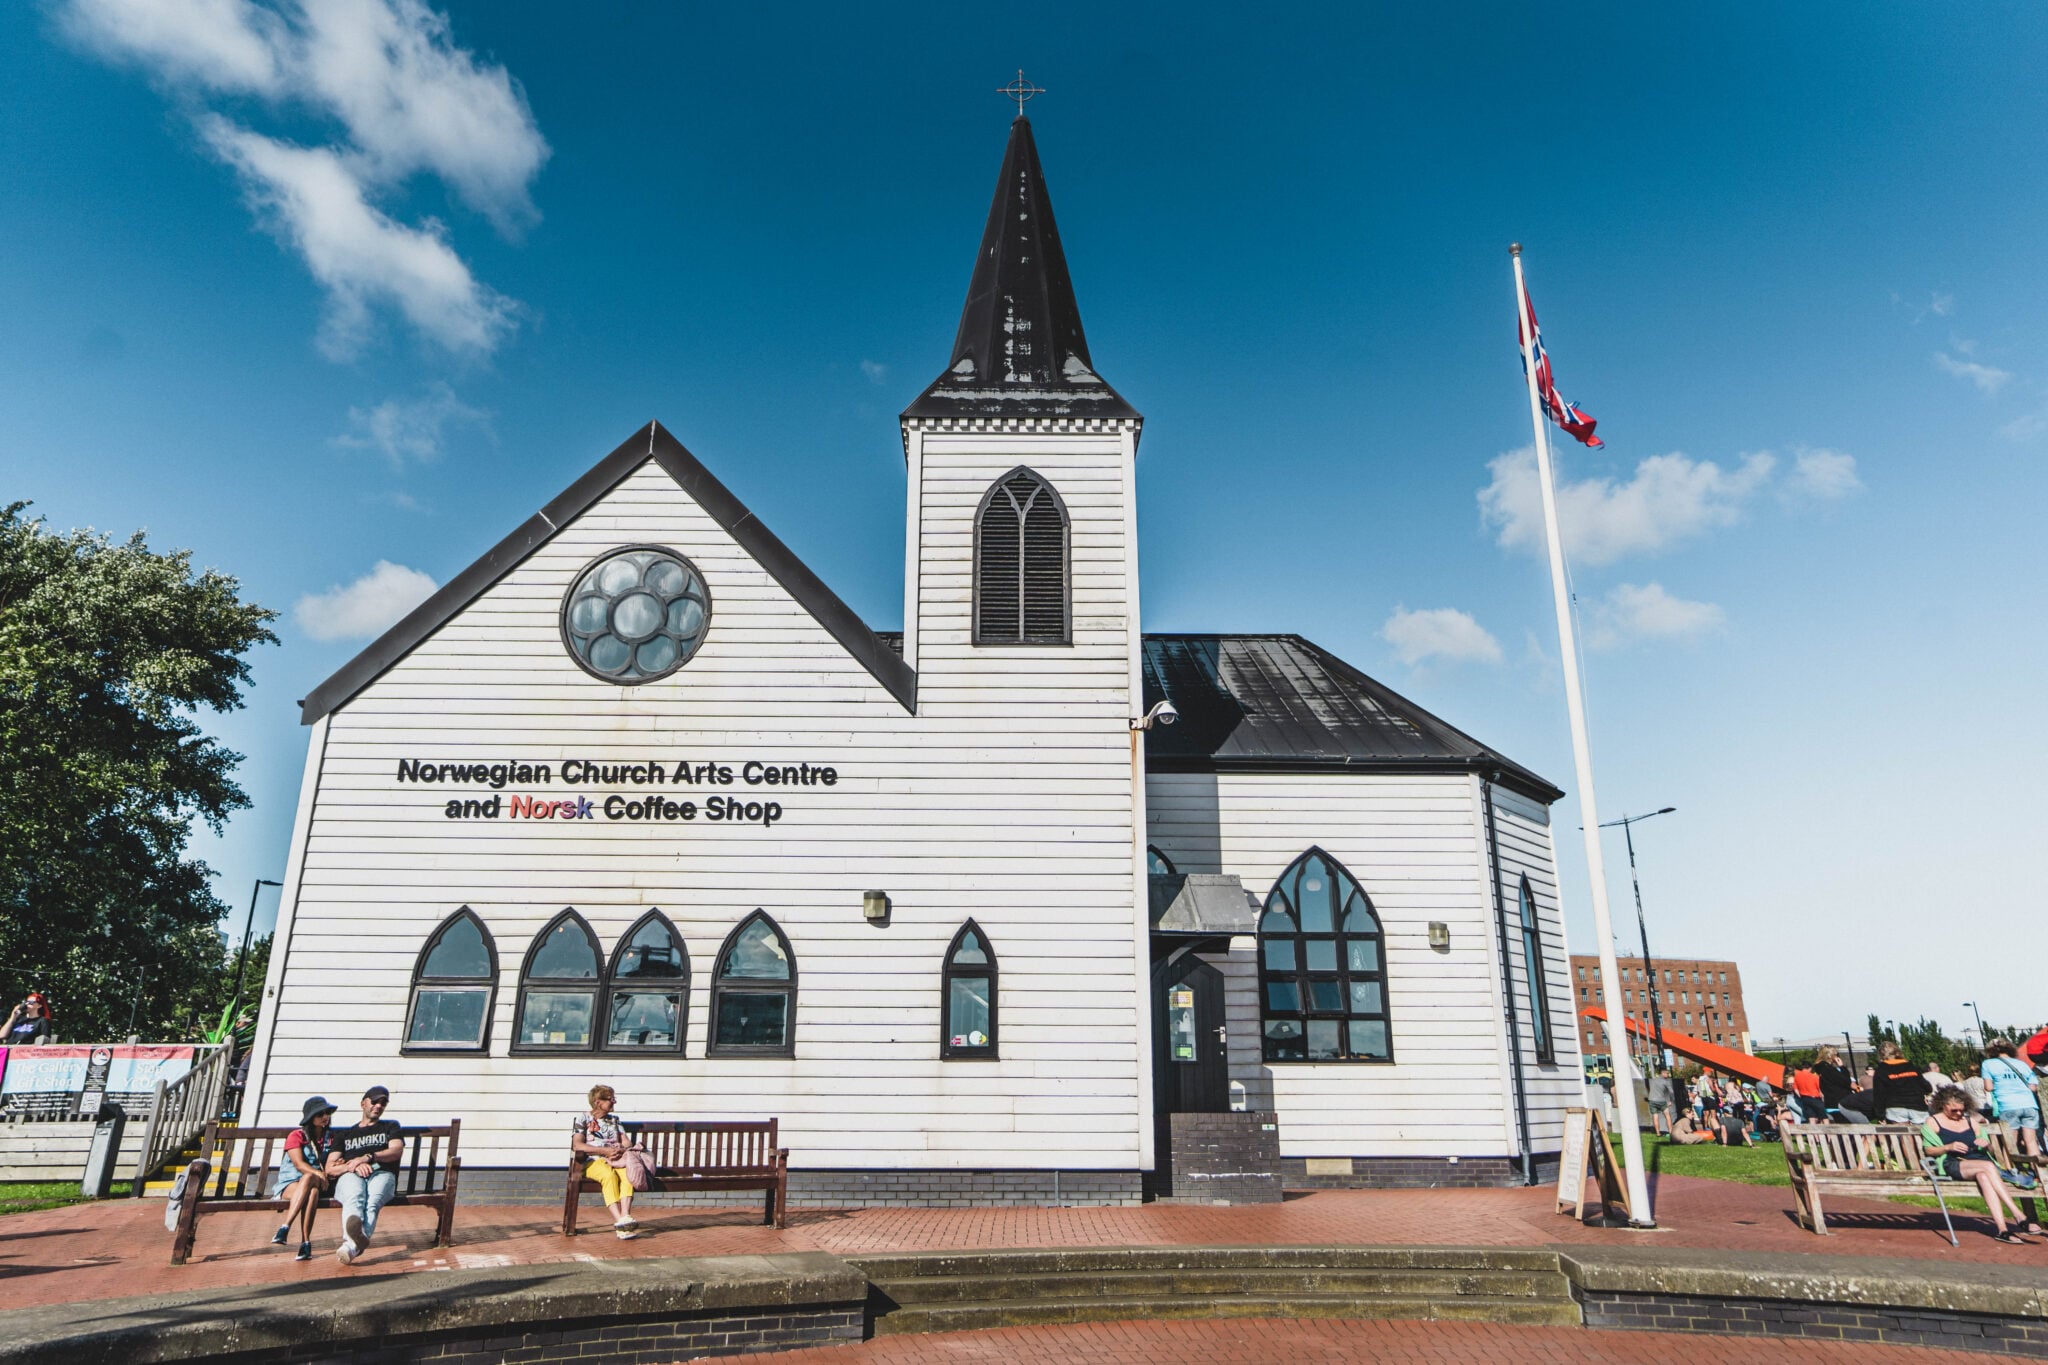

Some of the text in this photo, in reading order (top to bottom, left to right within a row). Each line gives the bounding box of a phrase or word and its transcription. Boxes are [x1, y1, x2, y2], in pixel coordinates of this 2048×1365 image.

[397, 759, 838, 789] Norwegian Church Arts Centre
[445, 795, 783, 827] and Norsk Coffee Shop
[15, 1060, 83, 1075] The Gallery
[43, 1075, 74, 1090] Shop
